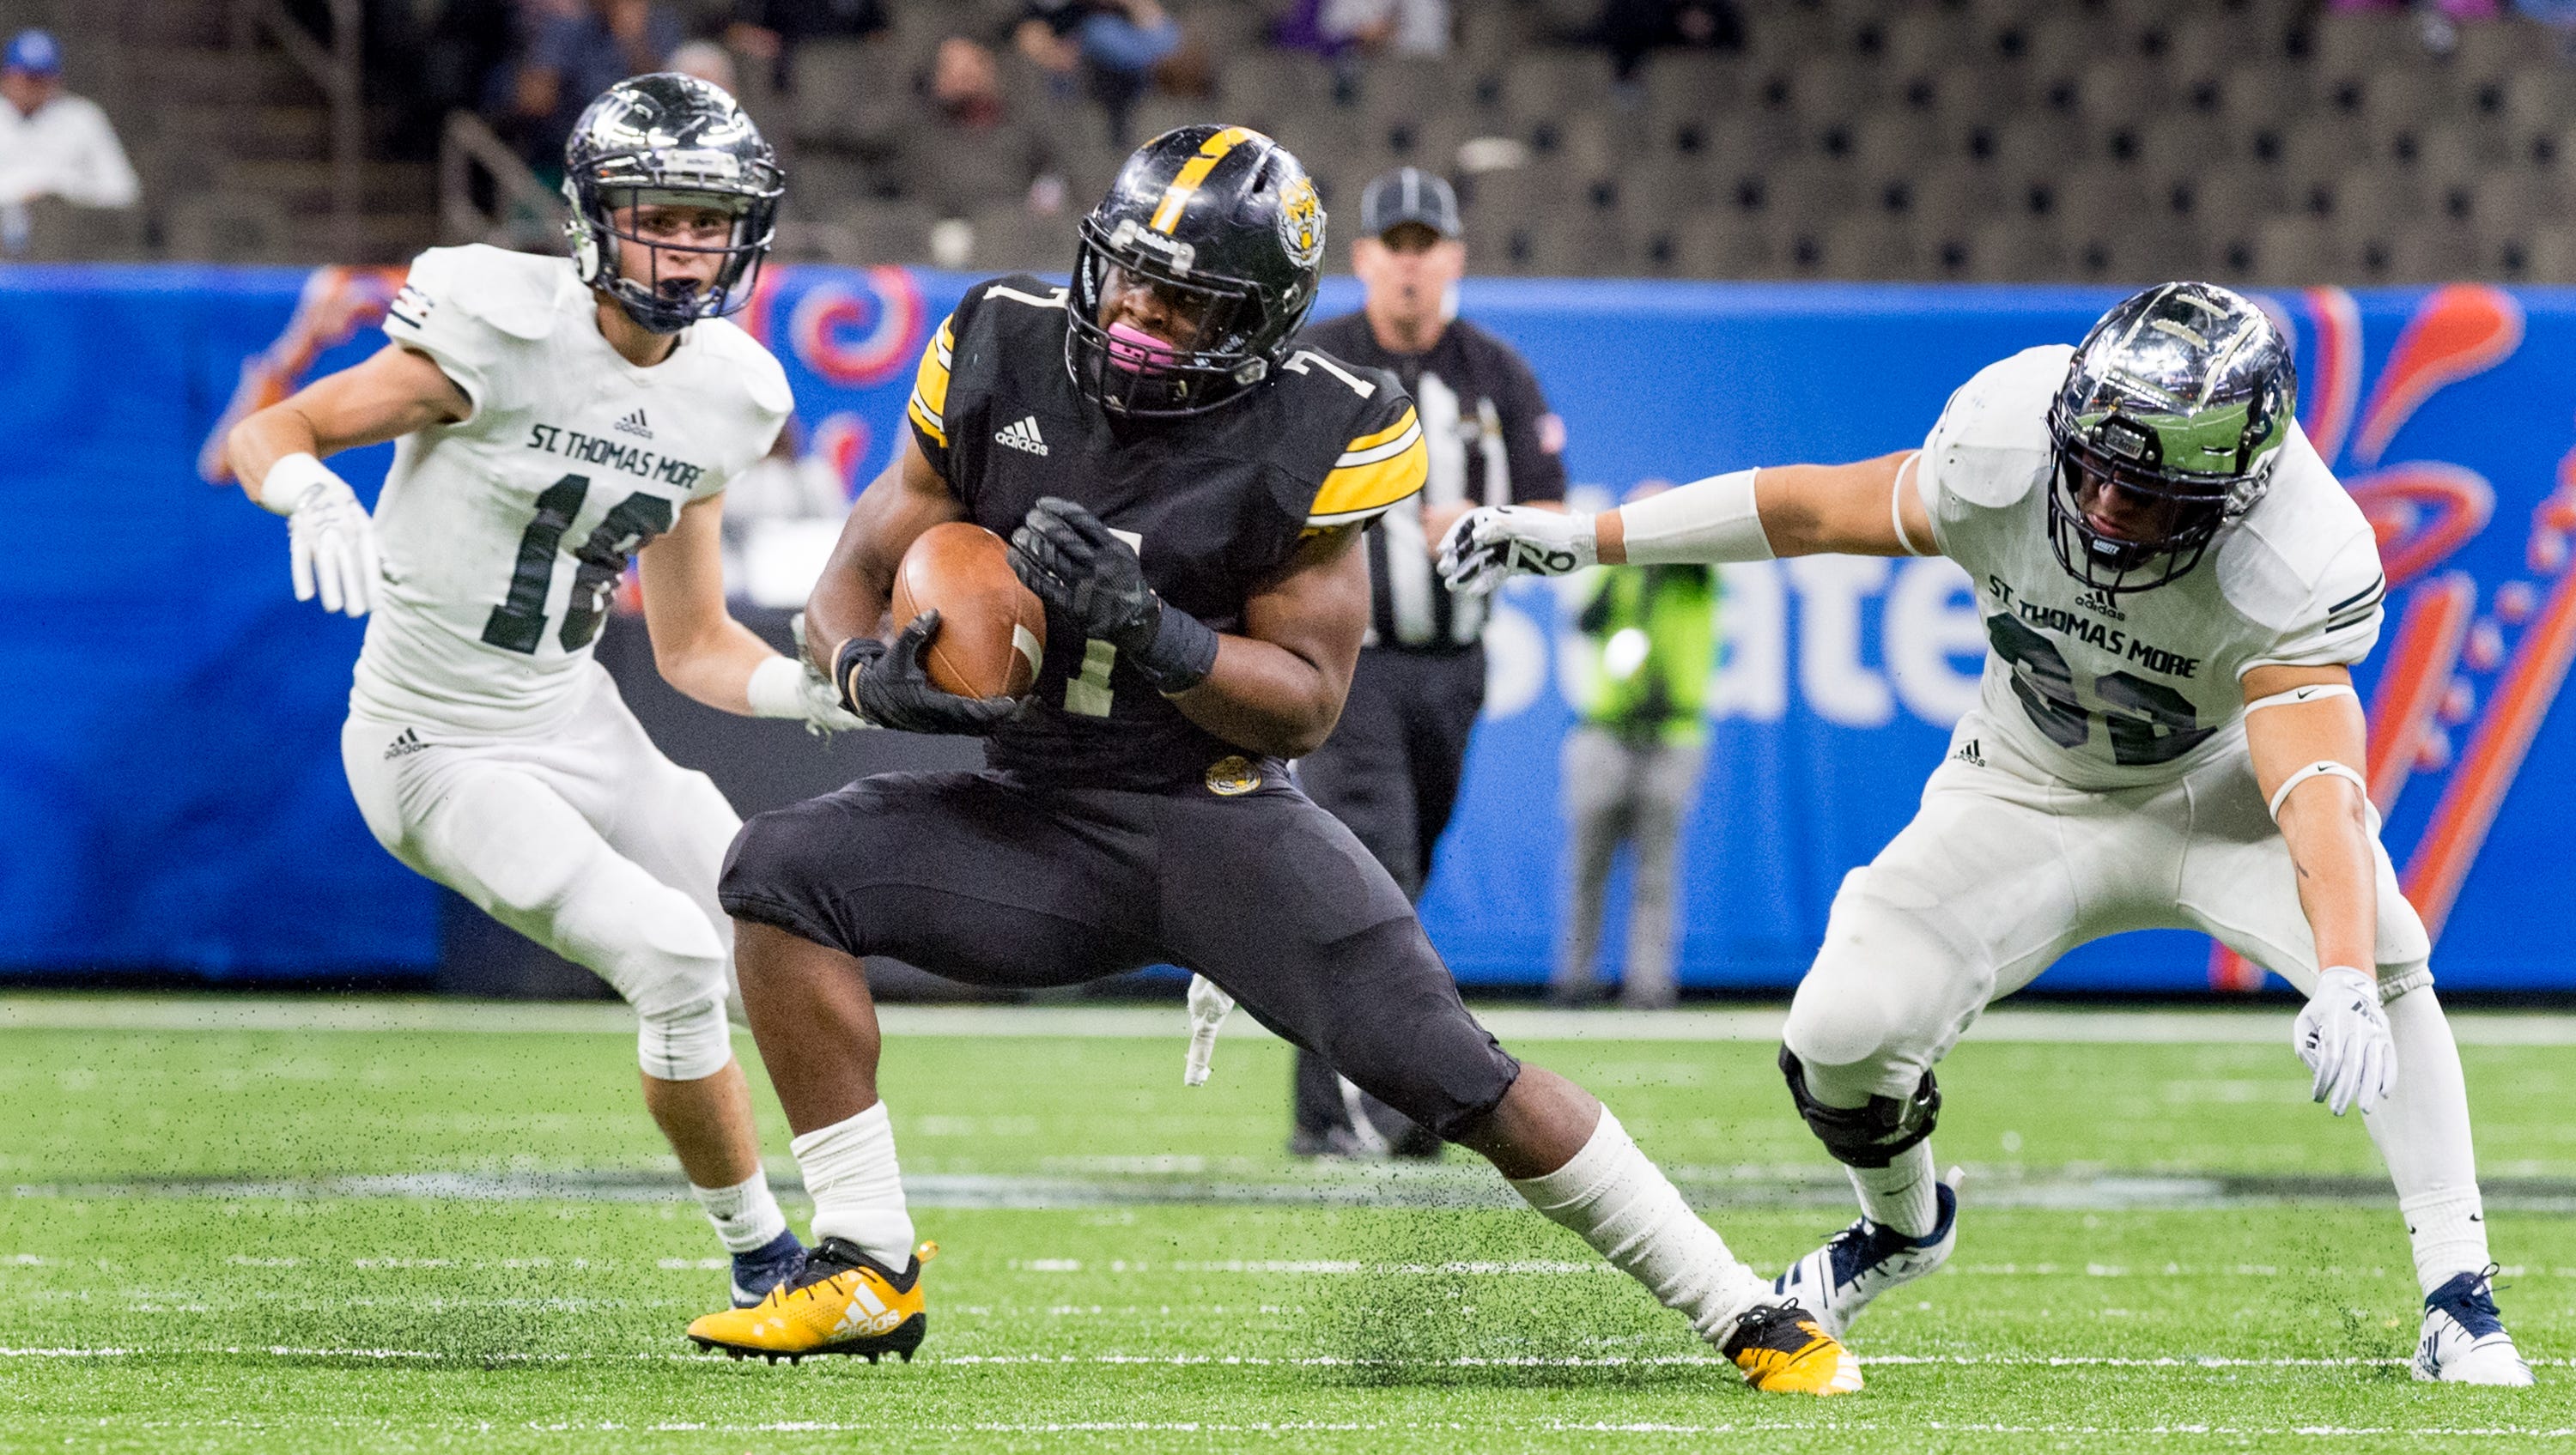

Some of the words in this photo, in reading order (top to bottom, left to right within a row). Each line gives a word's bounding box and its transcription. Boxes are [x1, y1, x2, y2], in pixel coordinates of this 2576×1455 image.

[1282, 350, 1376, 399] 7
[564, 431, 655, 477] THOMAS
[994, 431, 1049, 457] adidas
[2075, 595, 2127, 623] adidas
[2018, 598, 2127, 656] THOMAS
[2126, 639, 2201, 679] MORE
